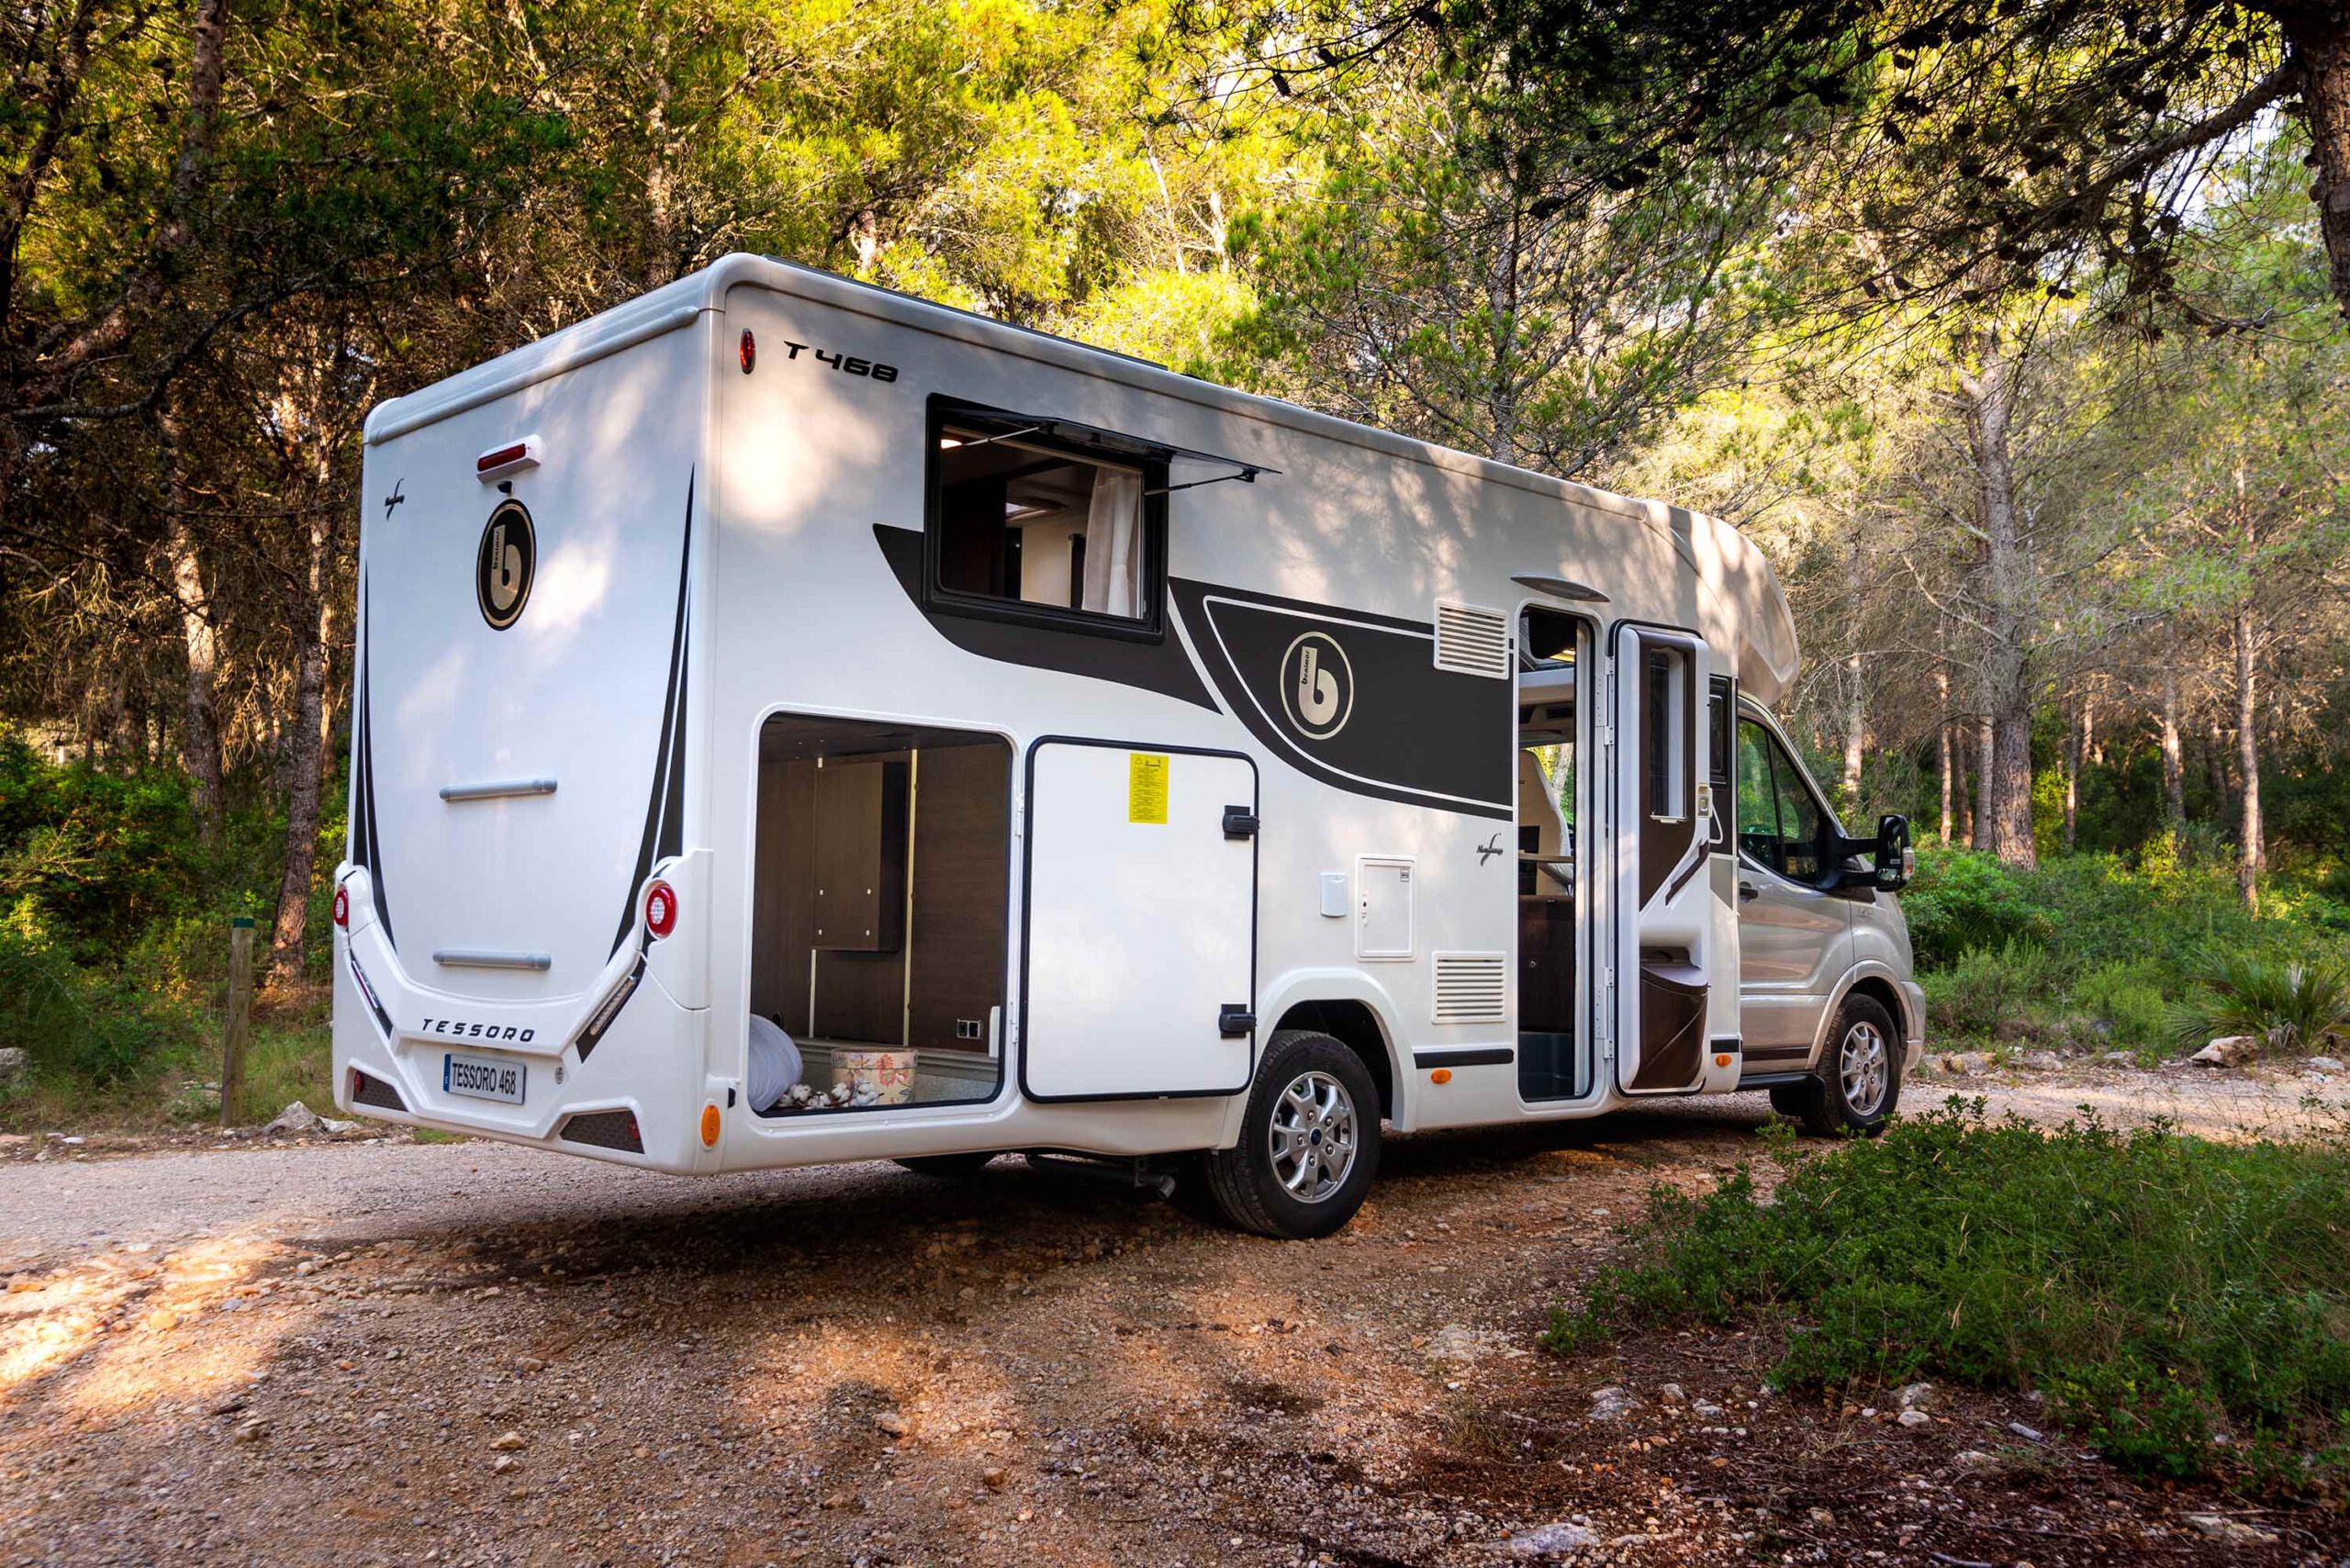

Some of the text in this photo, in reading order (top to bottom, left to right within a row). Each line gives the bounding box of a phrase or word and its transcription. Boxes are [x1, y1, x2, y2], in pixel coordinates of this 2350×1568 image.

[422, 1018, 535, 1042] TESSORO
[453, 1062, 516, 1095] TESSORO 468
